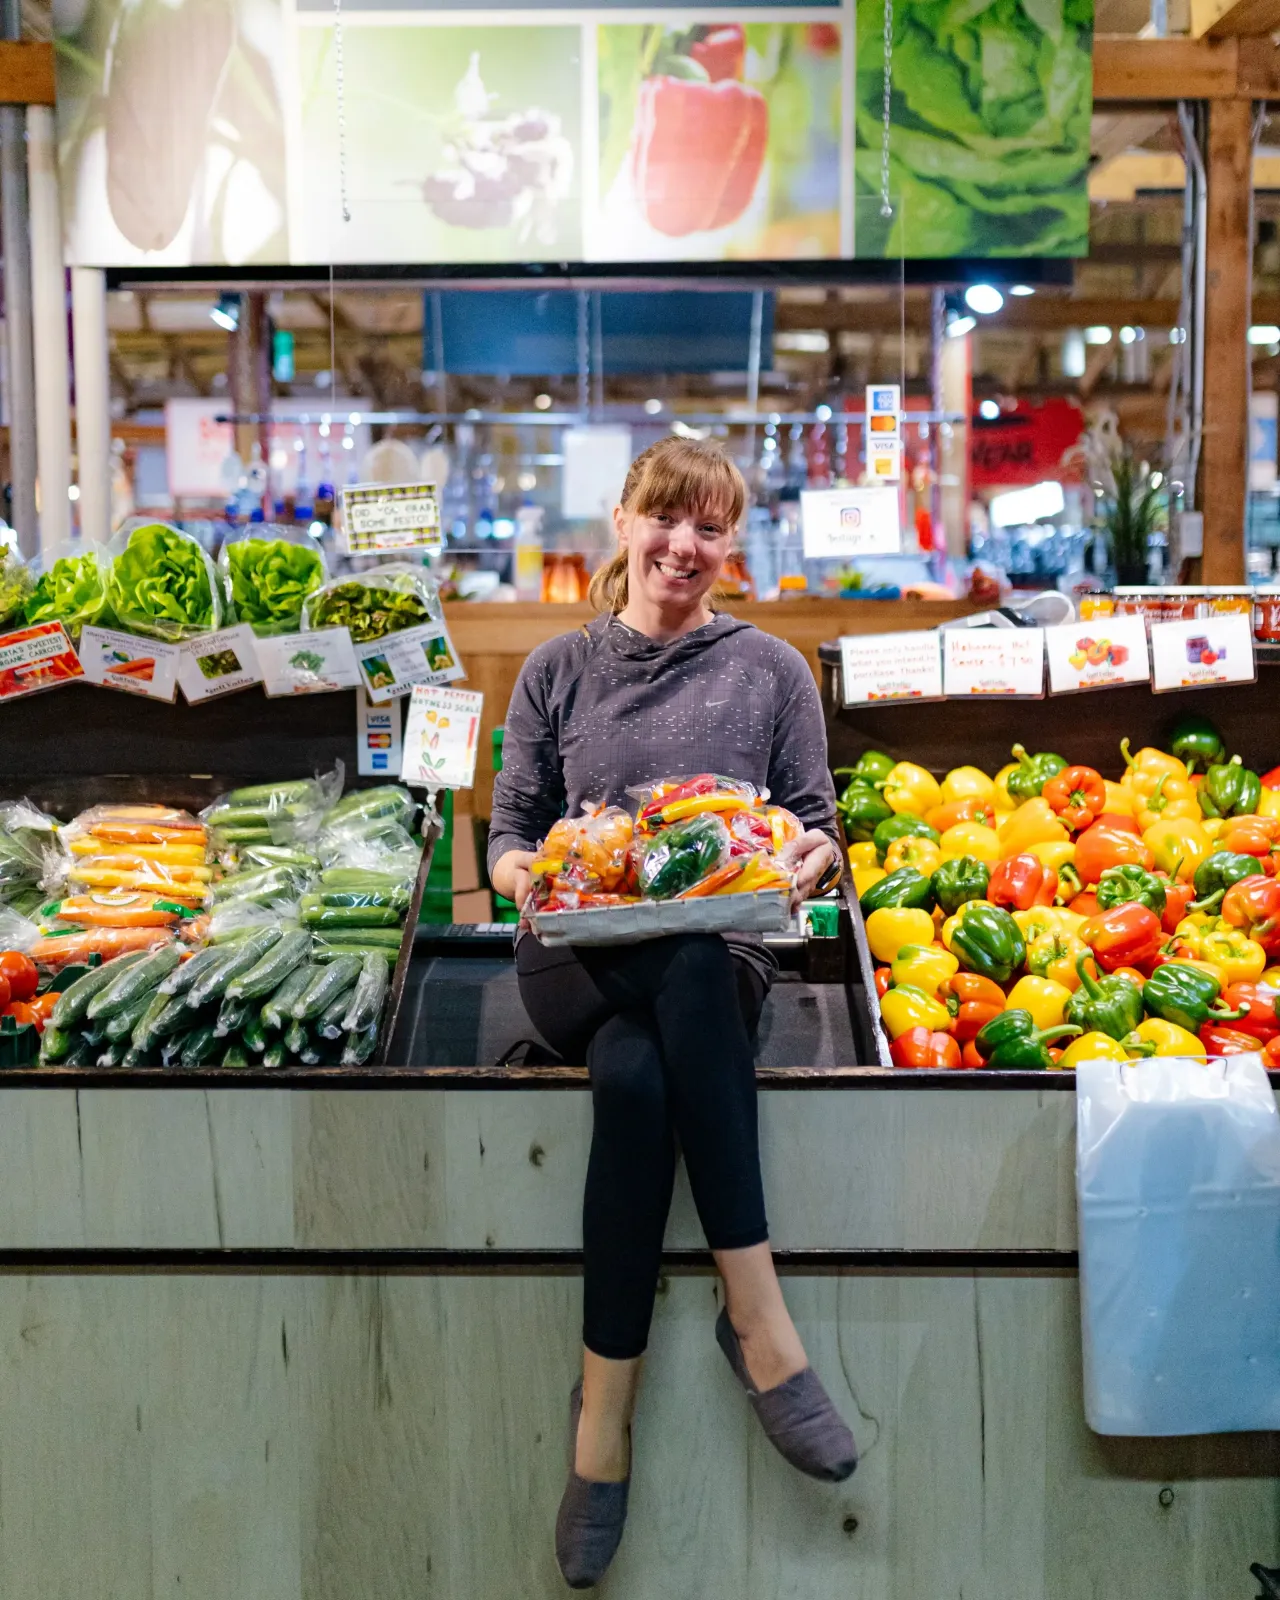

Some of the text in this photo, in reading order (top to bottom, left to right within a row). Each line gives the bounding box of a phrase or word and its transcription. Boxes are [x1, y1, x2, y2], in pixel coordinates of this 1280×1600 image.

[874, 442, 895, 450] VISA
[27, 635, 62, 650] SWEETEST
[416, 687, 440, 697] HOT
[370, 715, 391, 723] VISA
